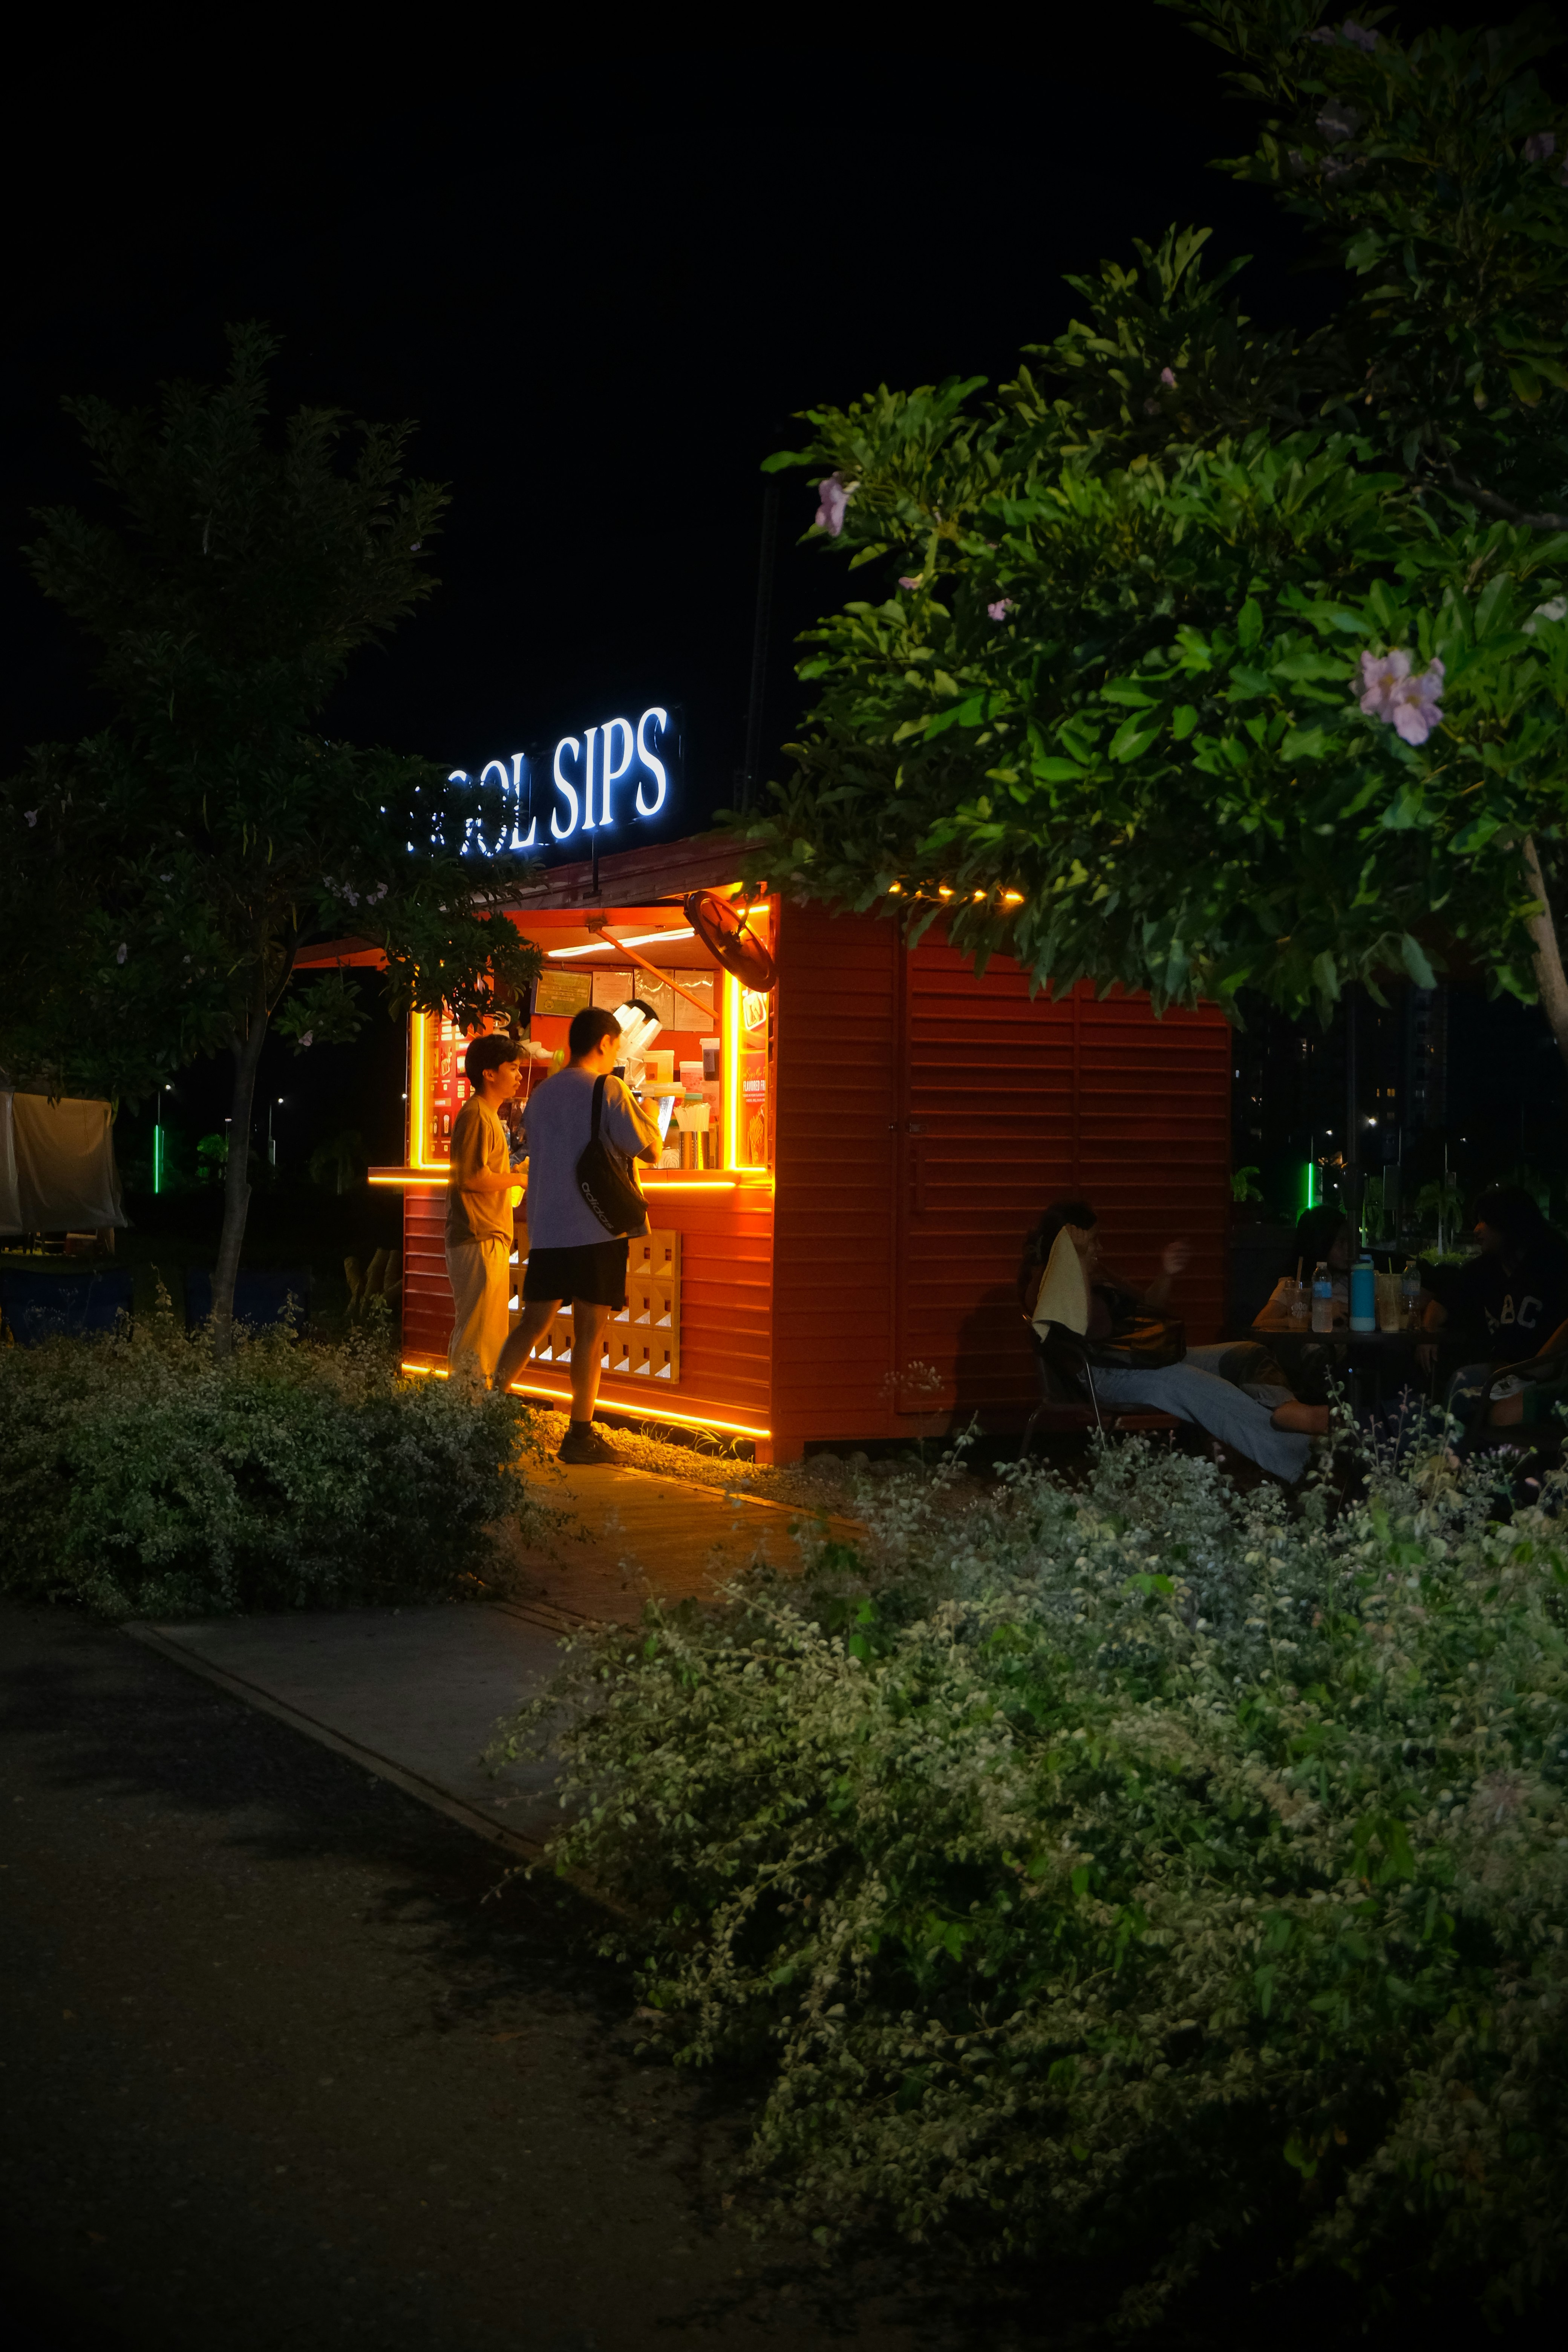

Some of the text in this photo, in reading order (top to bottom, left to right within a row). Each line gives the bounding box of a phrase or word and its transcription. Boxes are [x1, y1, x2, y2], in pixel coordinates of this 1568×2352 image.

[551, 707, 667, 839] SIPS
[743, 1080, 760, 1091] FLAVORED
[582, 1182, 614, 1228] adidas
